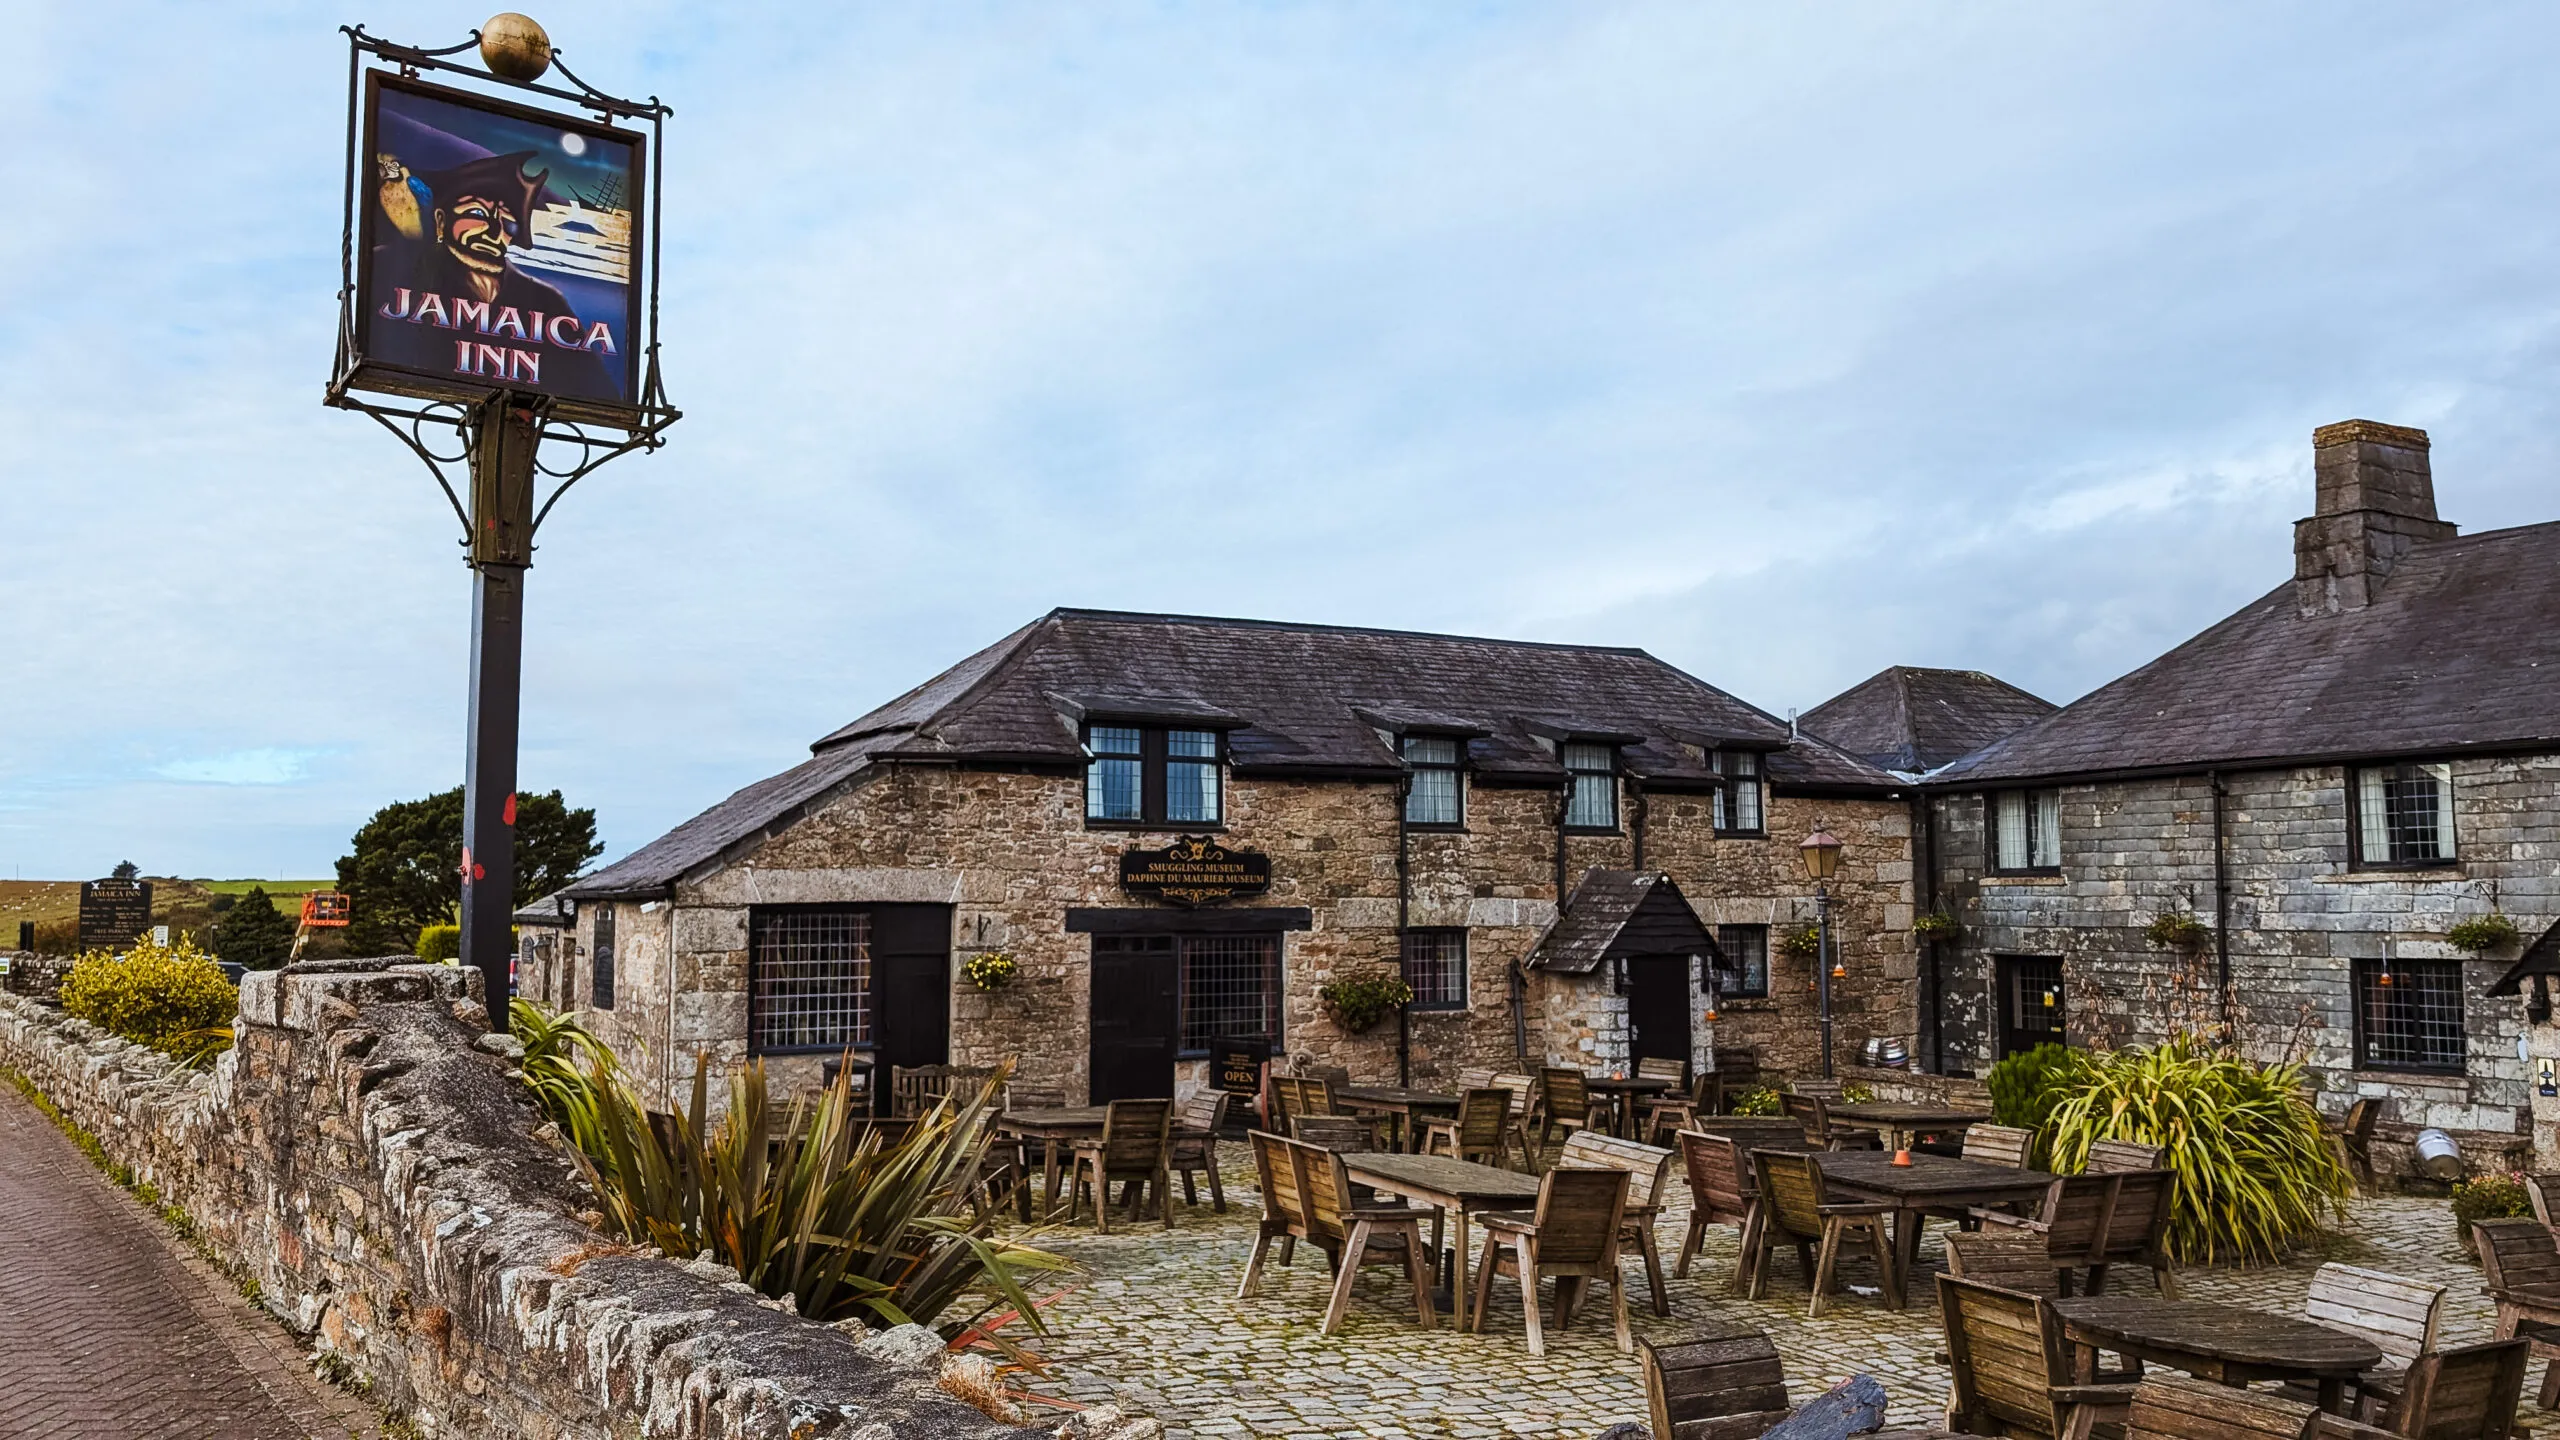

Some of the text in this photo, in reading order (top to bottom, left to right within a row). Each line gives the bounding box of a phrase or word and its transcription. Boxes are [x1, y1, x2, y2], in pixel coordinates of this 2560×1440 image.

[379, 287, 618, 354] JAMAICA
[455, 340, 541, 384] INN
[1148, 863, 1244, 873] SMUGGLING MUSEUM
[1127, 873, 1265, 884] DAPHNE DU MAURIER MUSEUM
[1224, 1070, 1254, 1082] OPEN
